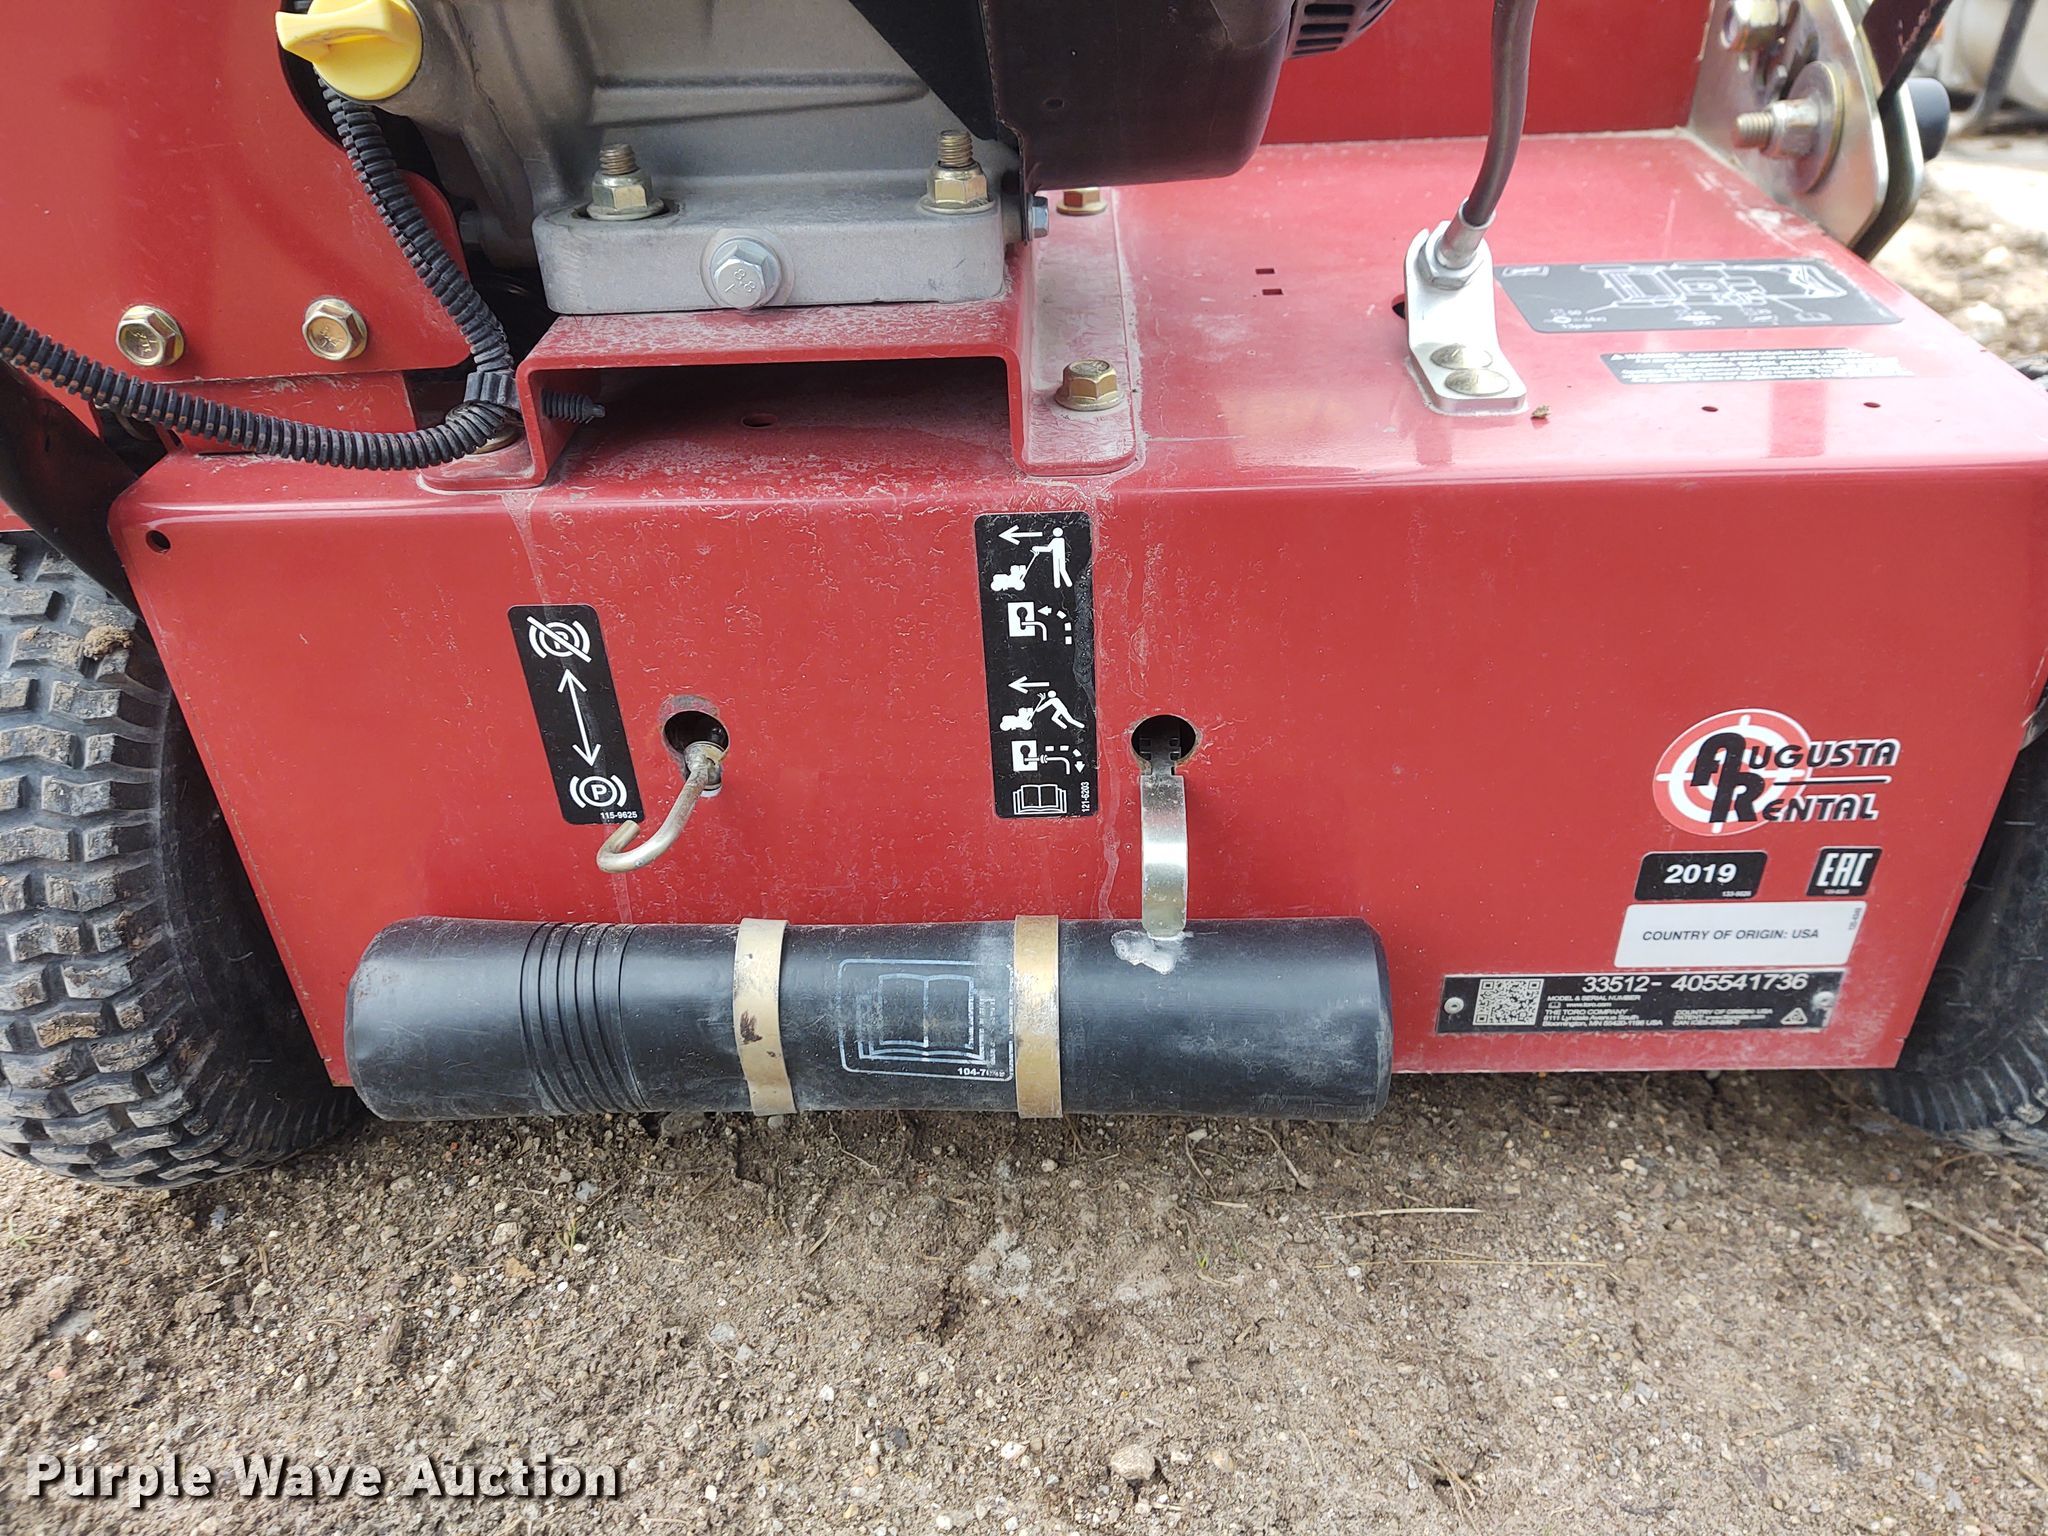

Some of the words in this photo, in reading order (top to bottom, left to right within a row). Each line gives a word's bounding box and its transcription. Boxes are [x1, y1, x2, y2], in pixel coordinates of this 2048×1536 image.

[1690, 732, 1900, 786] AUGUSTA
[1081, 780, 1090, 813] 121-6203
[600, 811, 638, 820] 115-9625
[1663, 863, 1738, 885] 2019
[1816, 852, 1874, 887] EAC
[1642, 930, 1710, 941] COUNTRY
[1712, 930, 1731, 940] OF
[1735, 929, 1788, 940] ORIGIN:
[1792, 929, 1819, 939] USA
[1582, 975, 1662, 993] 33512-
[1671, 973, 1809, 992] 405541736
